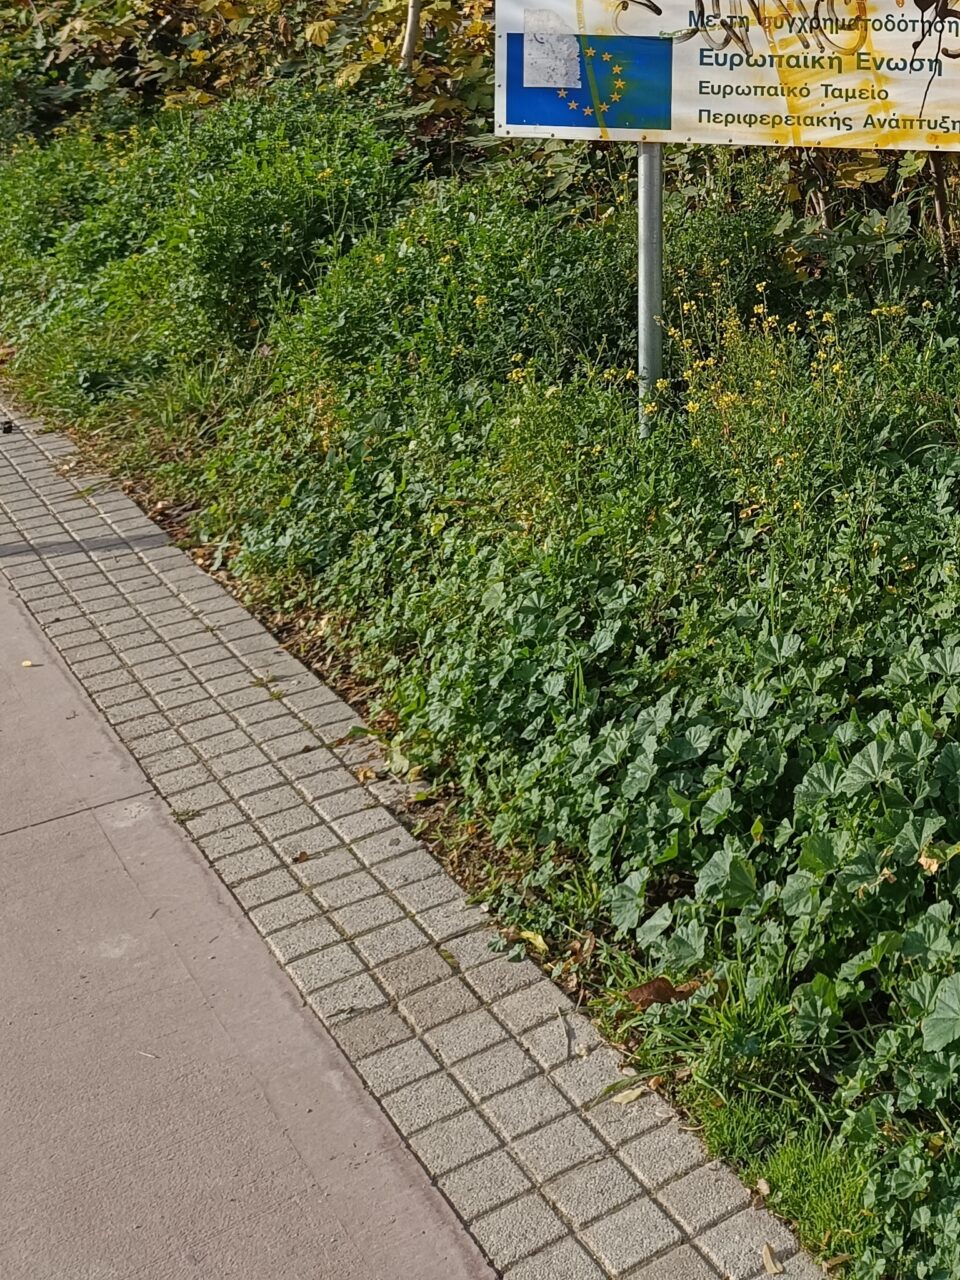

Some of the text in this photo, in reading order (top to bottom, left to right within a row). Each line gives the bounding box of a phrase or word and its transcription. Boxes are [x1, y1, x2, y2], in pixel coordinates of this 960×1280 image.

[699, 48, 843, 74] Ευρωπαϊκή
[698, 80, 889, 101] Ευρωπαϊκό Ταμείο
[698, 109, 853, 131] Περιφερειακής
